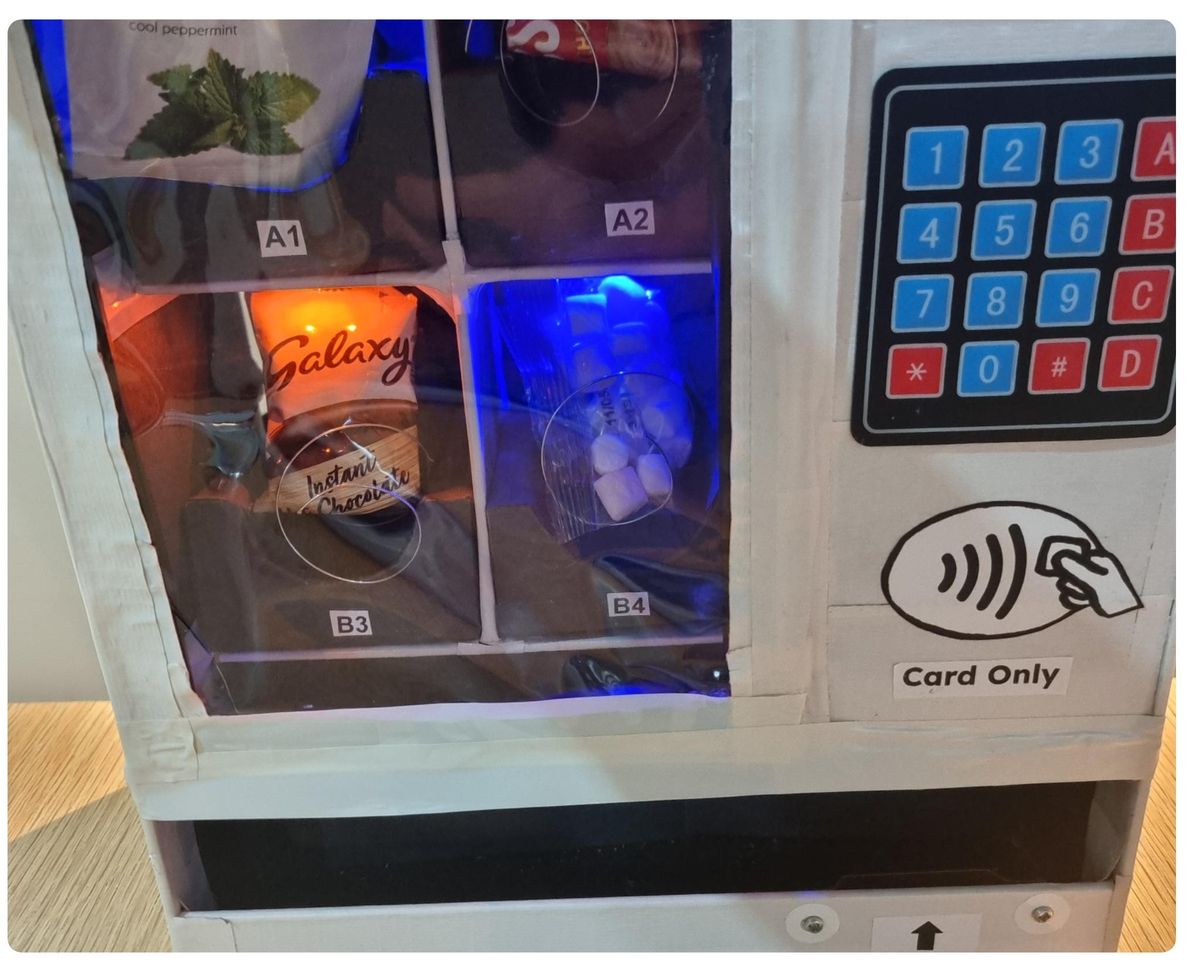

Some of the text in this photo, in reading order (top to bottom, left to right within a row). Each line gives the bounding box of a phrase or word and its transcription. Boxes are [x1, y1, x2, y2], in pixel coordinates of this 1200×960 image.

[128, 22, 238, 37] cool peppermint
[930, 132, 1176, 174] 1 2 3 A
[265, 225, 301, 249] A1
[612, 207, 649, 232] A2
[919, 209, 1166, 248] 4 5 6 B
[915, 280, 1153, 318] 7 8 9 C
[266, 330, 411, 392] Galaxy
[979, 354, 1000, 384] 0
[1120, 349, 1141, 378] D
[307, 450, 376, 498] Instant
[317, 467, 410, 515] Chocolate
[613, 597, 646, 616] B4
[336, 615, 368, 635] B3
[902, 663, 1060, 689] Card Only
